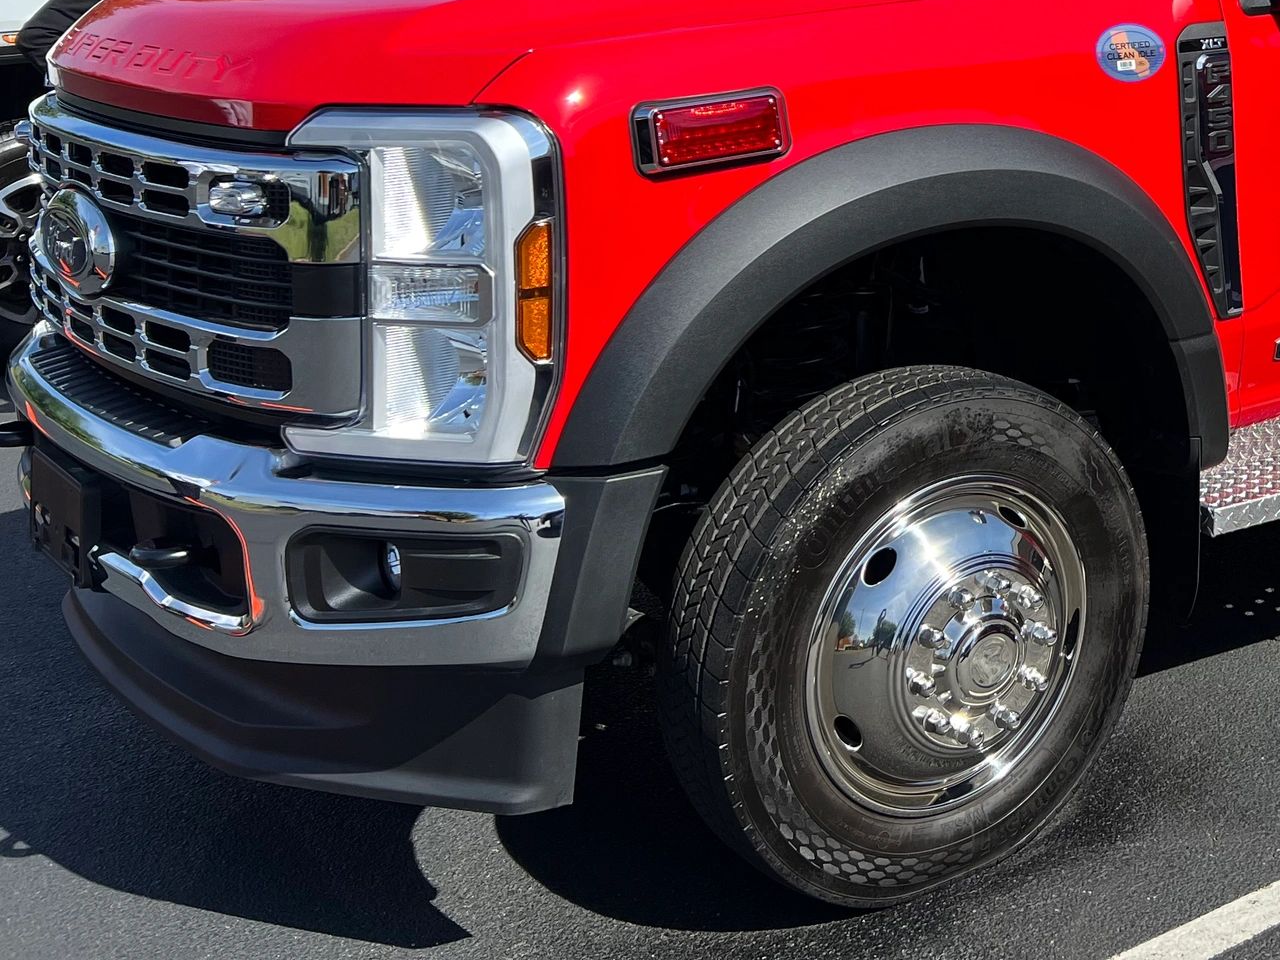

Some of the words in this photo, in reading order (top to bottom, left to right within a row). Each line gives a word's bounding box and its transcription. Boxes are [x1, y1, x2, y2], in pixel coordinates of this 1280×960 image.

[1109, 40, 1151, 50] CERTIFIED
[1200, 37, 1225, 50] XLT
[1106, 51, 1135, 61] CLEAN
[1138, 49, 1157, 58] IDLE
[124, 42, 251, 82] DUTY
